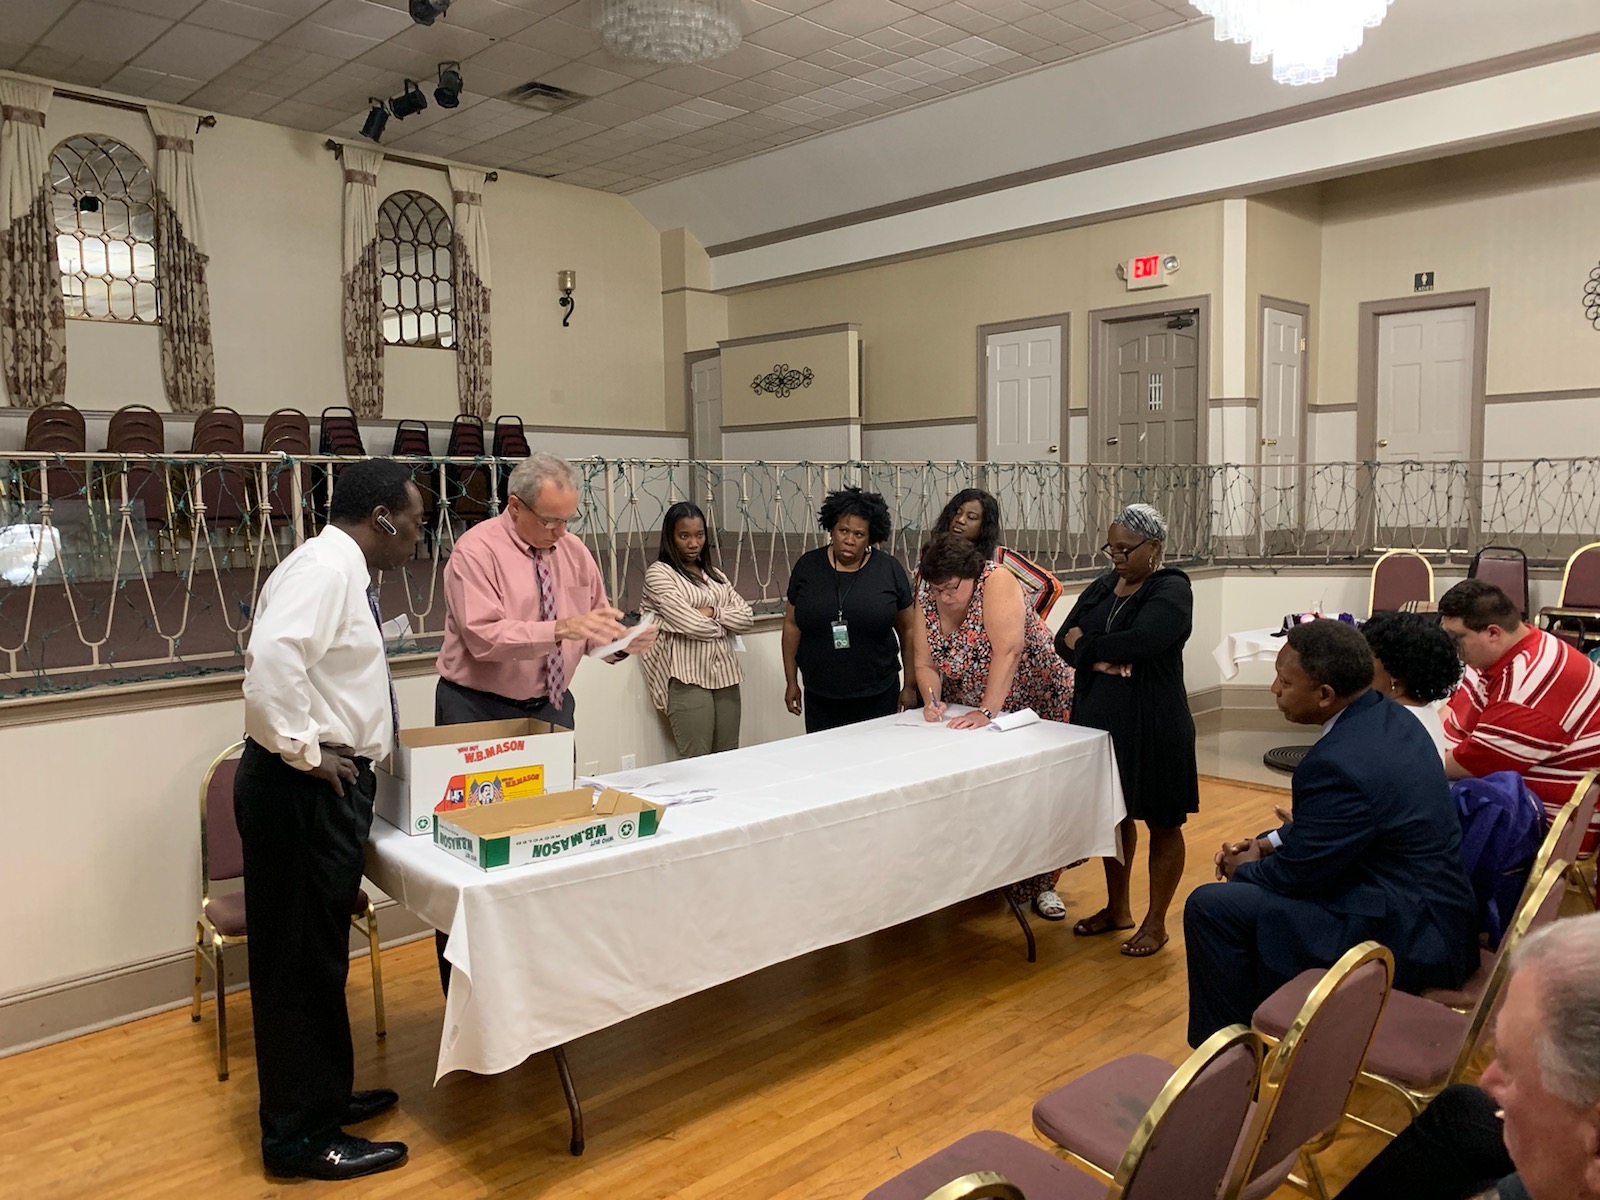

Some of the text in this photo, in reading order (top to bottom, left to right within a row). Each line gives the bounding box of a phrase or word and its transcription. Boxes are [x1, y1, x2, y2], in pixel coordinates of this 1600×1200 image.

[1134, 255, 1160, 279] EXIT
[516, 834, 561, 845] RECYCLED
[532, 823, 607, 858] W.B.MASON
[590, 835, 614, 847] WHO BUT
